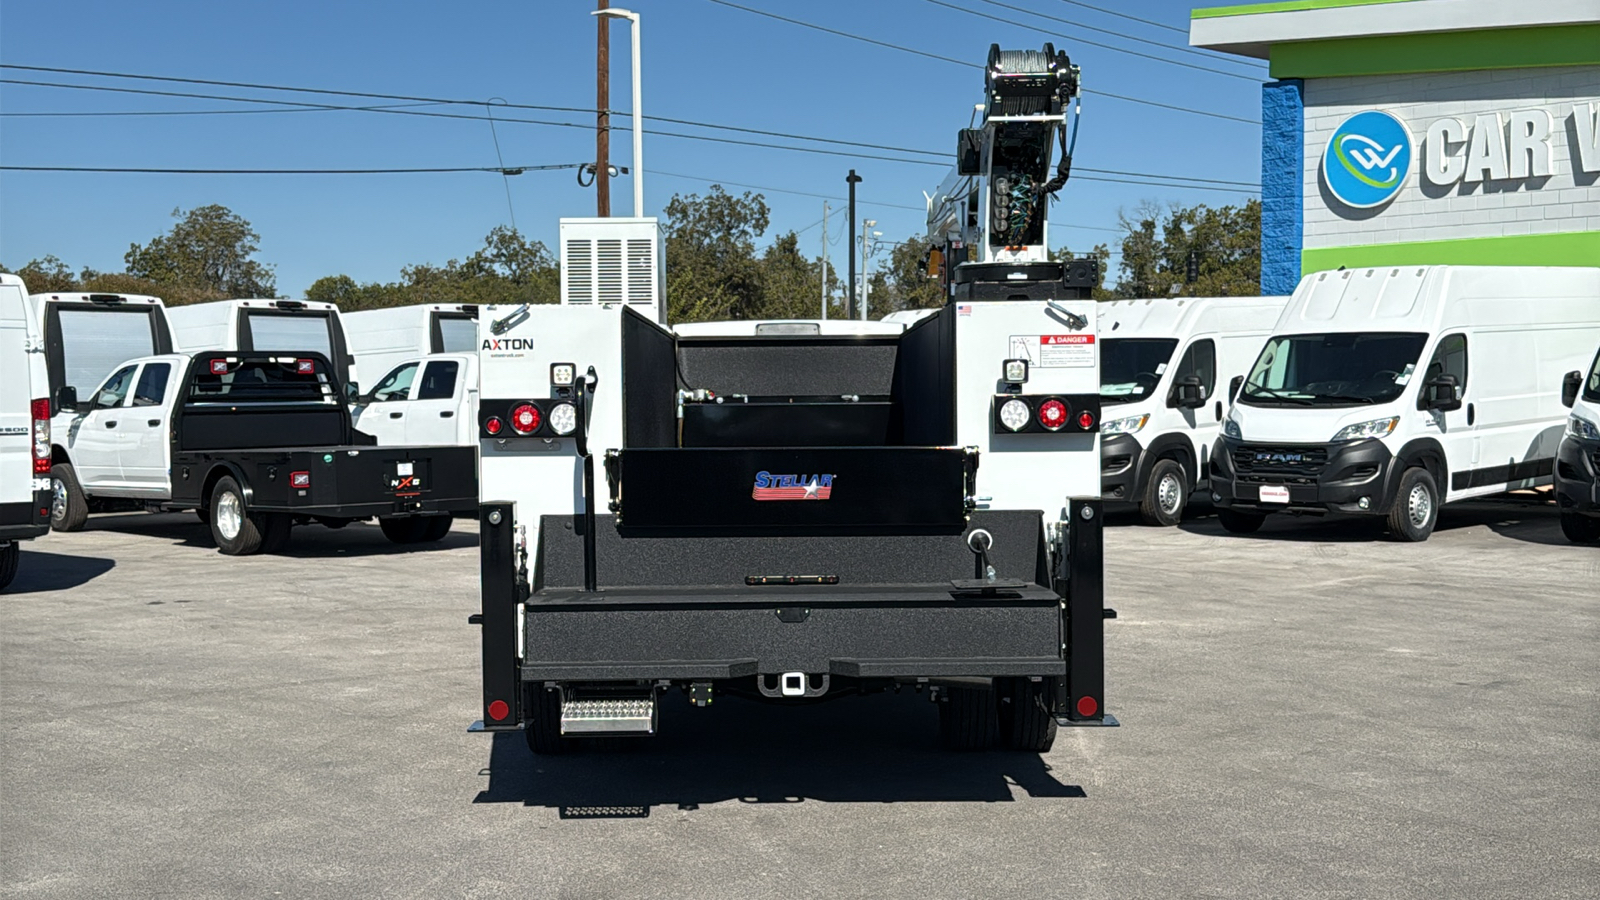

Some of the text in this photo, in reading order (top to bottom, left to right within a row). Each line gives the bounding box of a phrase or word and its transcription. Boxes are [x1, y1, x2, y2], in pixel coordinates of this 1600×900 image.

[1425, 109, 1554, 186] CAR
[482, 338, 534, 351] AXTON
[1056, 336, 1088, 344] DANGER
[1256, 454, 1302, 462] RAM
[754, 470, 834, 489] STELLAR
